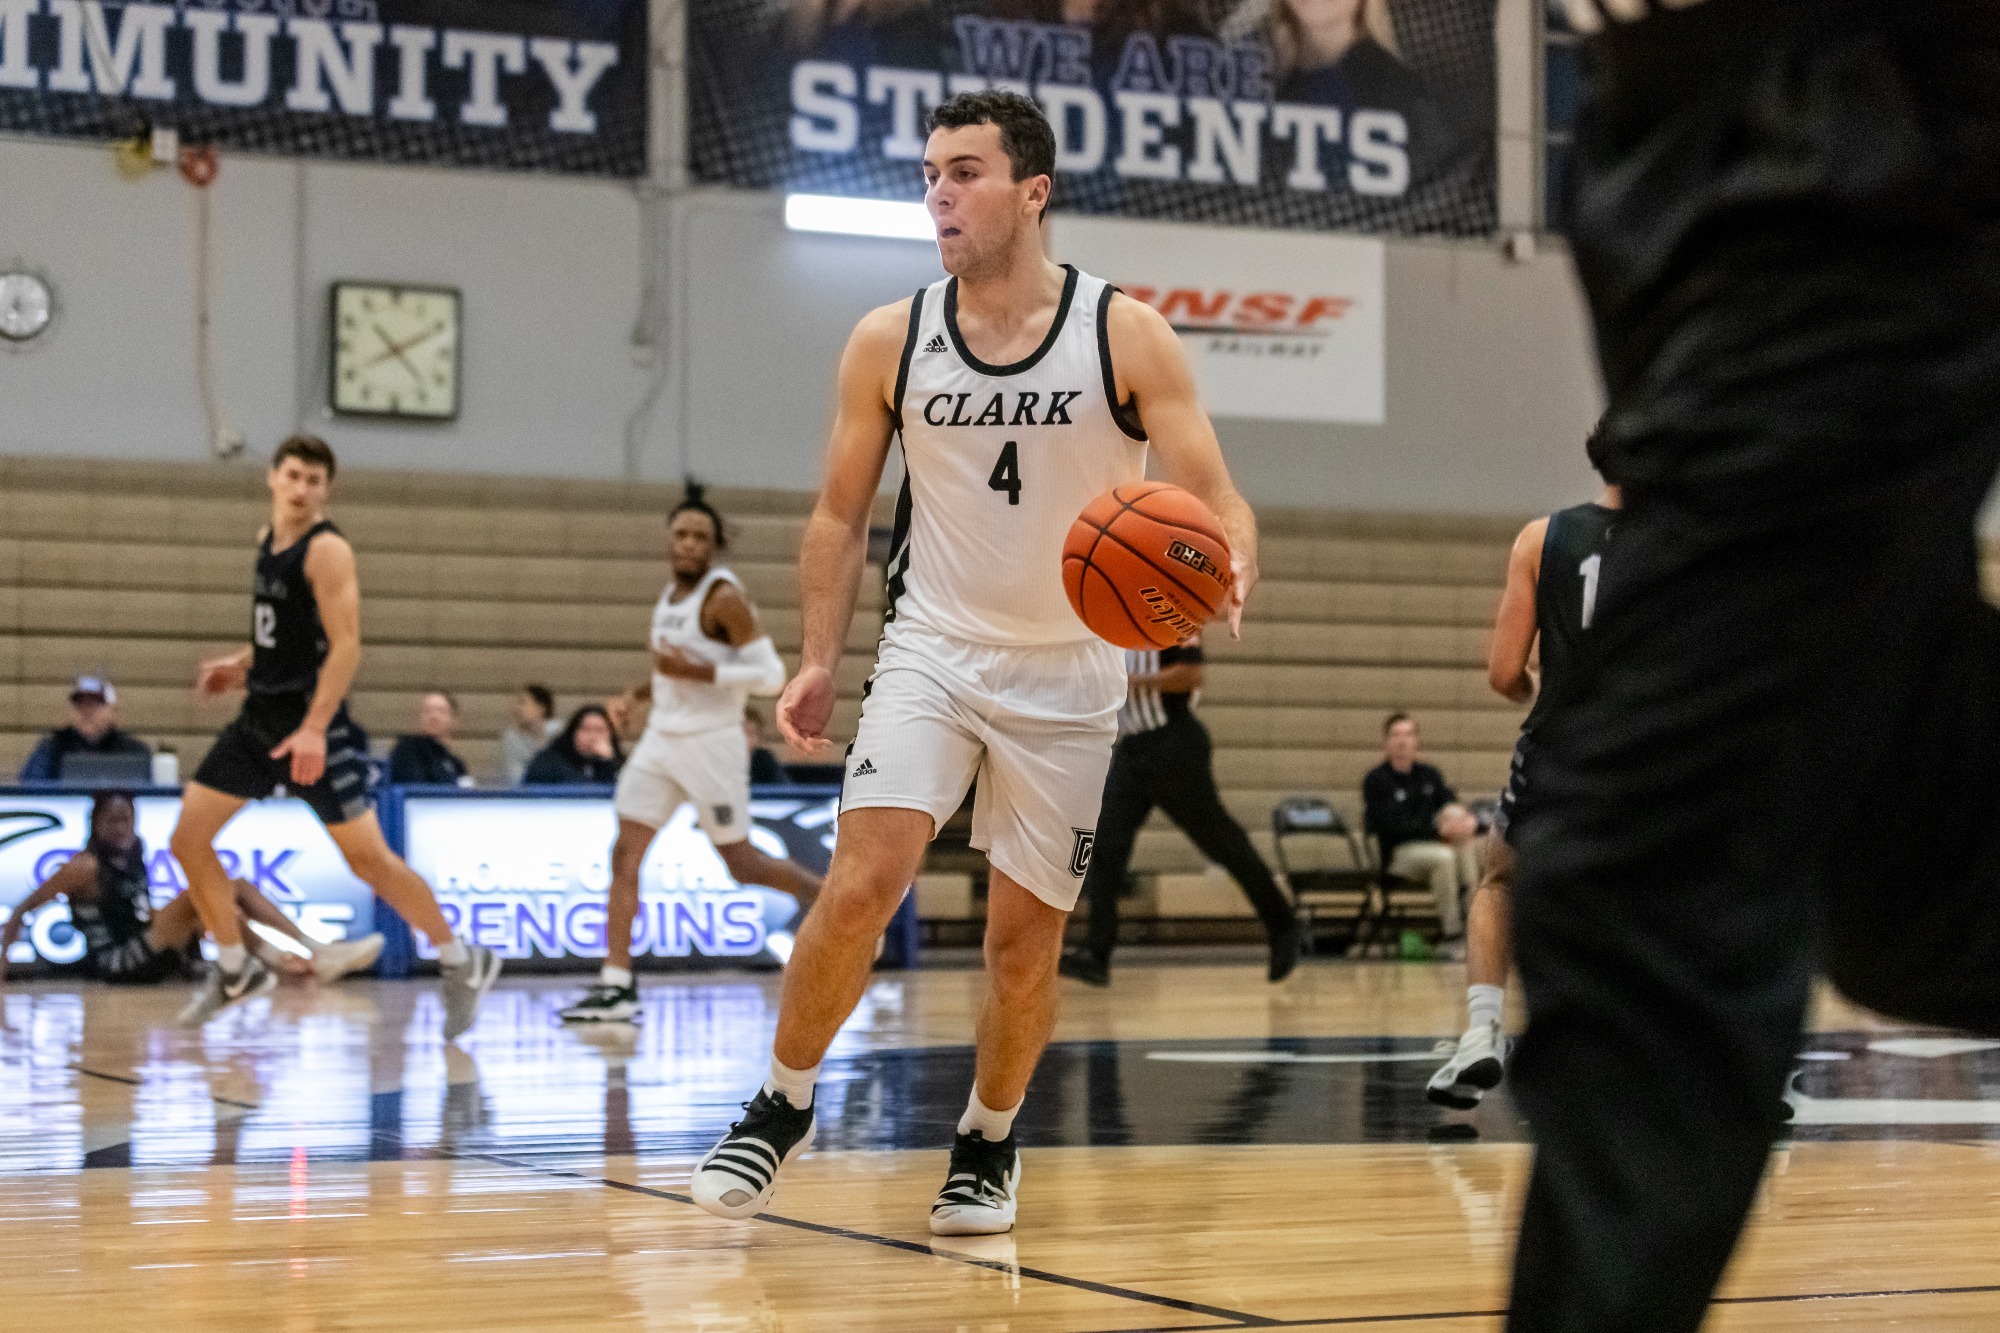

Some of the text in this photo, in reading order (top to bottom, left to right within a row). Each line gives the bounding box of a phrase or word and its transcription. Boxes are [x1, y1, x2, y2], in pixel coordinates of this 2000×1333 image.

[953, 13, 1276, 103] WE ARE
[789, 59, 1411, 196] STDENTS
[923, 345, 948, 353] adidas
[923, 390, 1083, 427] CLARK
[988, 441, 1022, 506] 4
[852, 766, 878, 778] adidas
